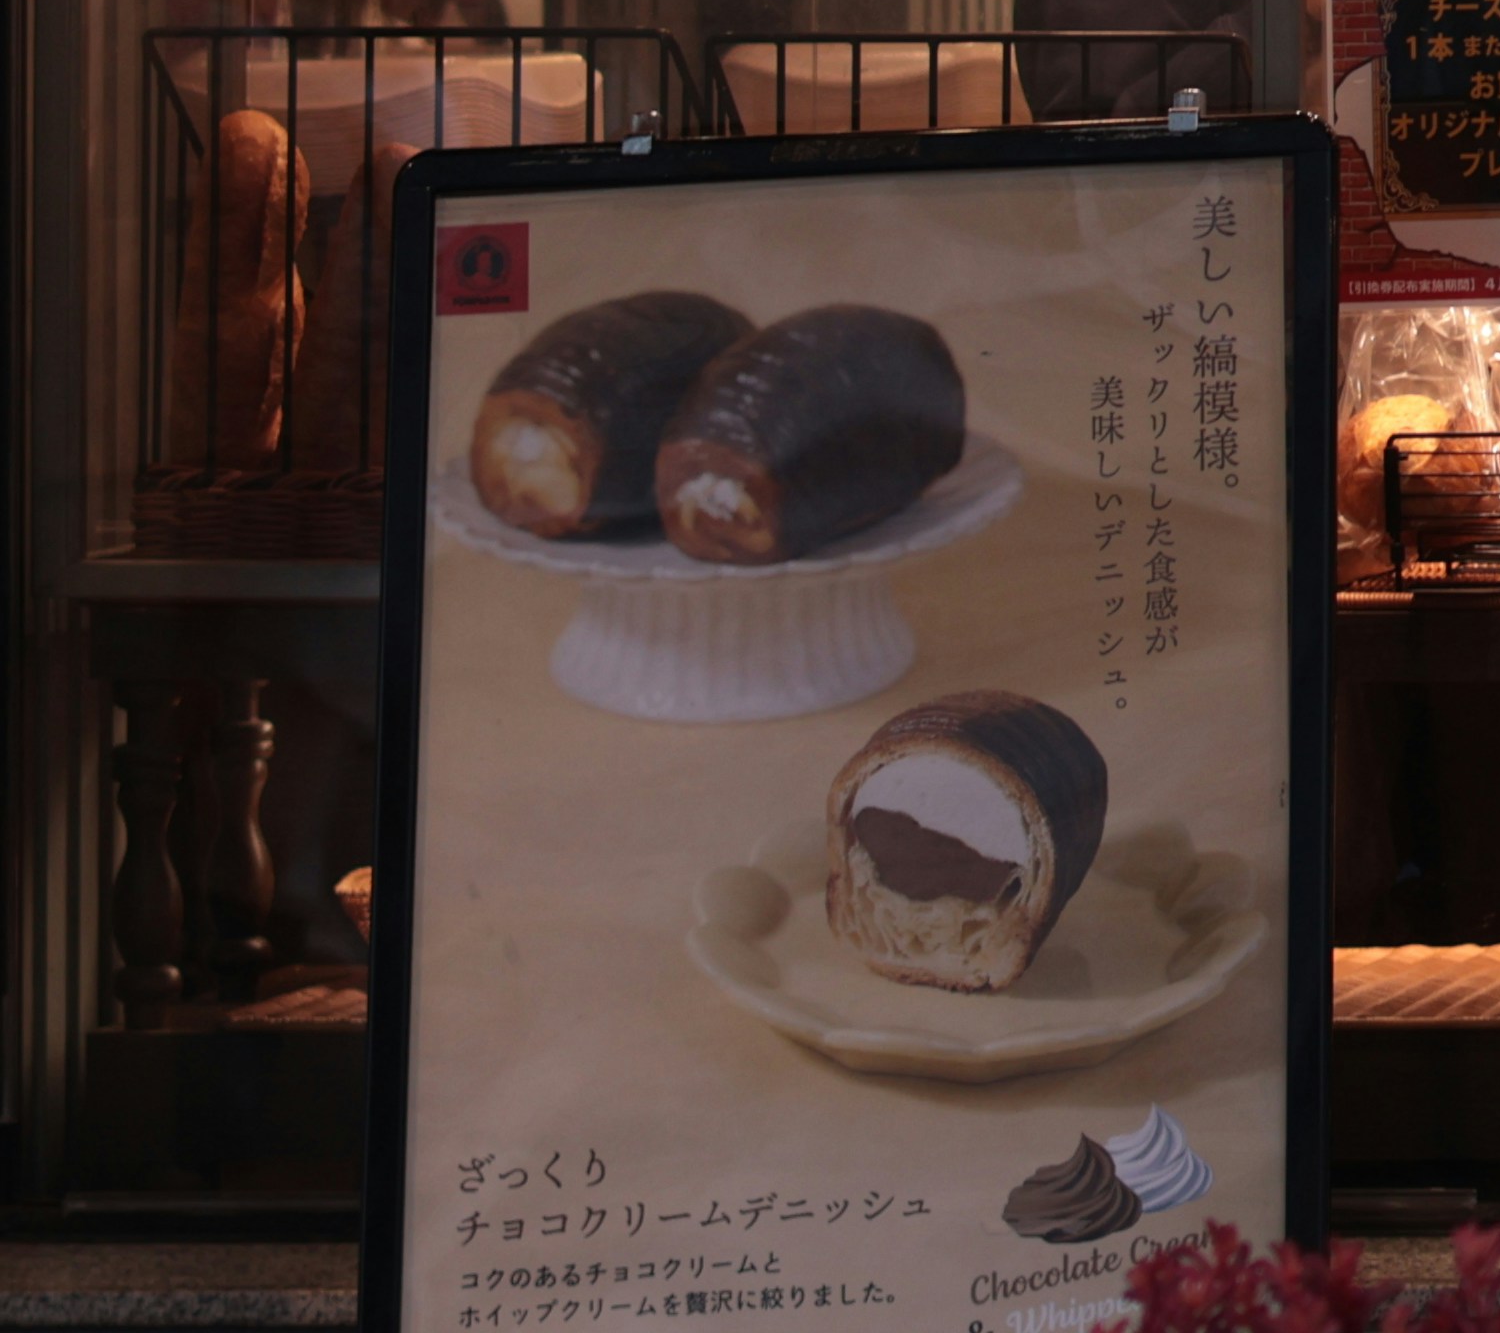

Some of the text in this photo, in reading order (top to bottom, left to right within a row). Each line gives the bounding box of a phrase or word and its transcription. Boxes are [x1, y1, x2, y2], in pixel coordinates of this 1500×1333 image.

[1192, 195, 1240, 490] 美しい縞模様。
[1142, 303, 1180, 656] ザックリとした食感が
[1089, 375, 1129, 713] 美味しいデニッシュ。
[458, 1148, 609, 1194] ざっくり
[456, 1189, 934, 1247] チョコクリームデニッシュ
[460, 1253, 782, 1291] コクのあるチョコクリームと
[970, 1247, 1123, 1305] Chocolate
[458, 1282, 898, 1329] ホイップクリームを贅沢に絞りました。
